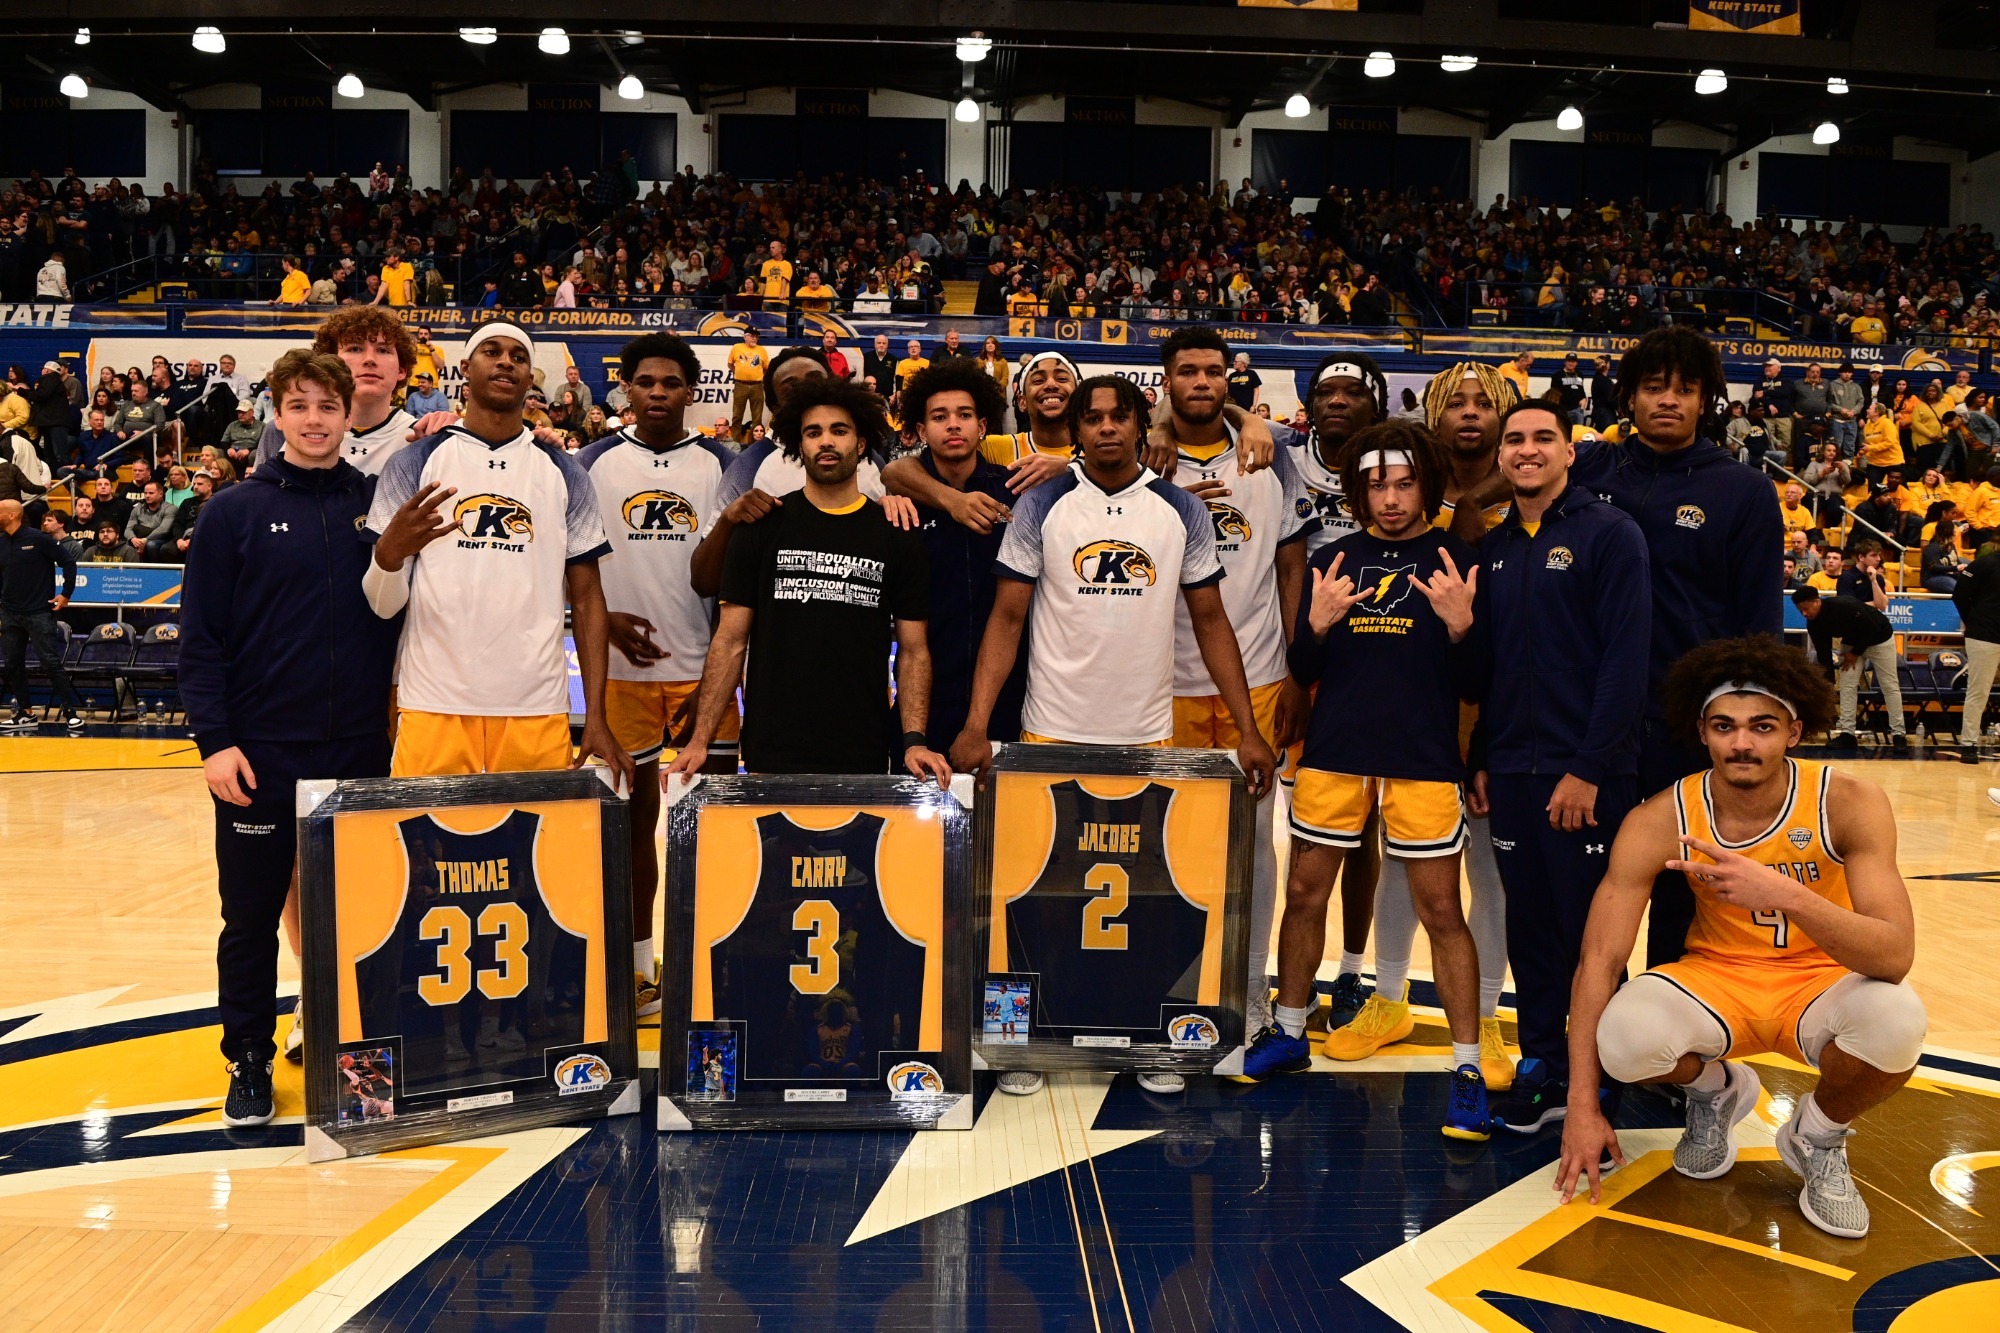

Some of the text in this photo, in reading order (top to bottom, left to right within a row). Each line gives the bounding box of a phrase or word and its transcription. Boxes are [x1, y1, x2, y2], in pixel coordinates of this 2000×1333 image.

[1708, 0, 1782, 14] KENT STATE
[268, 95, 325, 107] SECTION
[535, 97, 593, 110] SECTION
[0, 303, 74, 328] TATE
[397, 309, 467, 325] GETHER,
[520, 310, 544, 325] GO
[548, 311, 636, 327] FORWARD.
[641, 312, 678, 327] KSU.
[1576, 336, 1606, 351] ALL
[1742, 342, 1764, 356] GO
[1767, 343, 1846, 359] FORWARD.
[1850, 347, 1884, 361] KSU.
[640, 499, 677, 531] K
[471, 504, 517, 541] K
[1324, 519, 1355, 529] STATE
[628, 533, 686, 542] KENT STATE
[457, 539, 525, 553] KENT STATE
[776, 555, 807, 565] UNITY
[816, 551, 880, 569] EQUALITY
[816, 563, 853, 579] unity
[1092, 551, 1135, 584] K
[102, 575, 119, 583] Crystal
[852, 569, 883, 583] INCLUSION
[782, 577, 845, 590] INCLUSION
[850, 583, 881, 595] EQUALITY
[774, 587, 813, 604] unity
[812, 591, 845, 602] INCLUSION
[854, 591, 881, 603] UNITY
[1078, 586, 1144, 596] KENT STATE
[1882, 604, 1914, 617] LINIC
[1348, 616, 1414, 628] KENT STATE
[1352, 625, 1408, 635] BASKETBALL
[232, 821, 252, 830] KENT
[1078, 822, 1141, 854] JACOBS
[434, 857, 510, 894] THOMAS
[791, 855, 847, 888] CARRY
[1081, 862, 1129, 950] 2
[417, 901, 530, 1007] 33
[789, 899, 840, 995] 3
[1182, 1023, 1205, 1041] K
[570, 1062, 595, 1085] K
[580, 1083, 601, 1091] STATE
[903, 1071, 927, 1091] K
